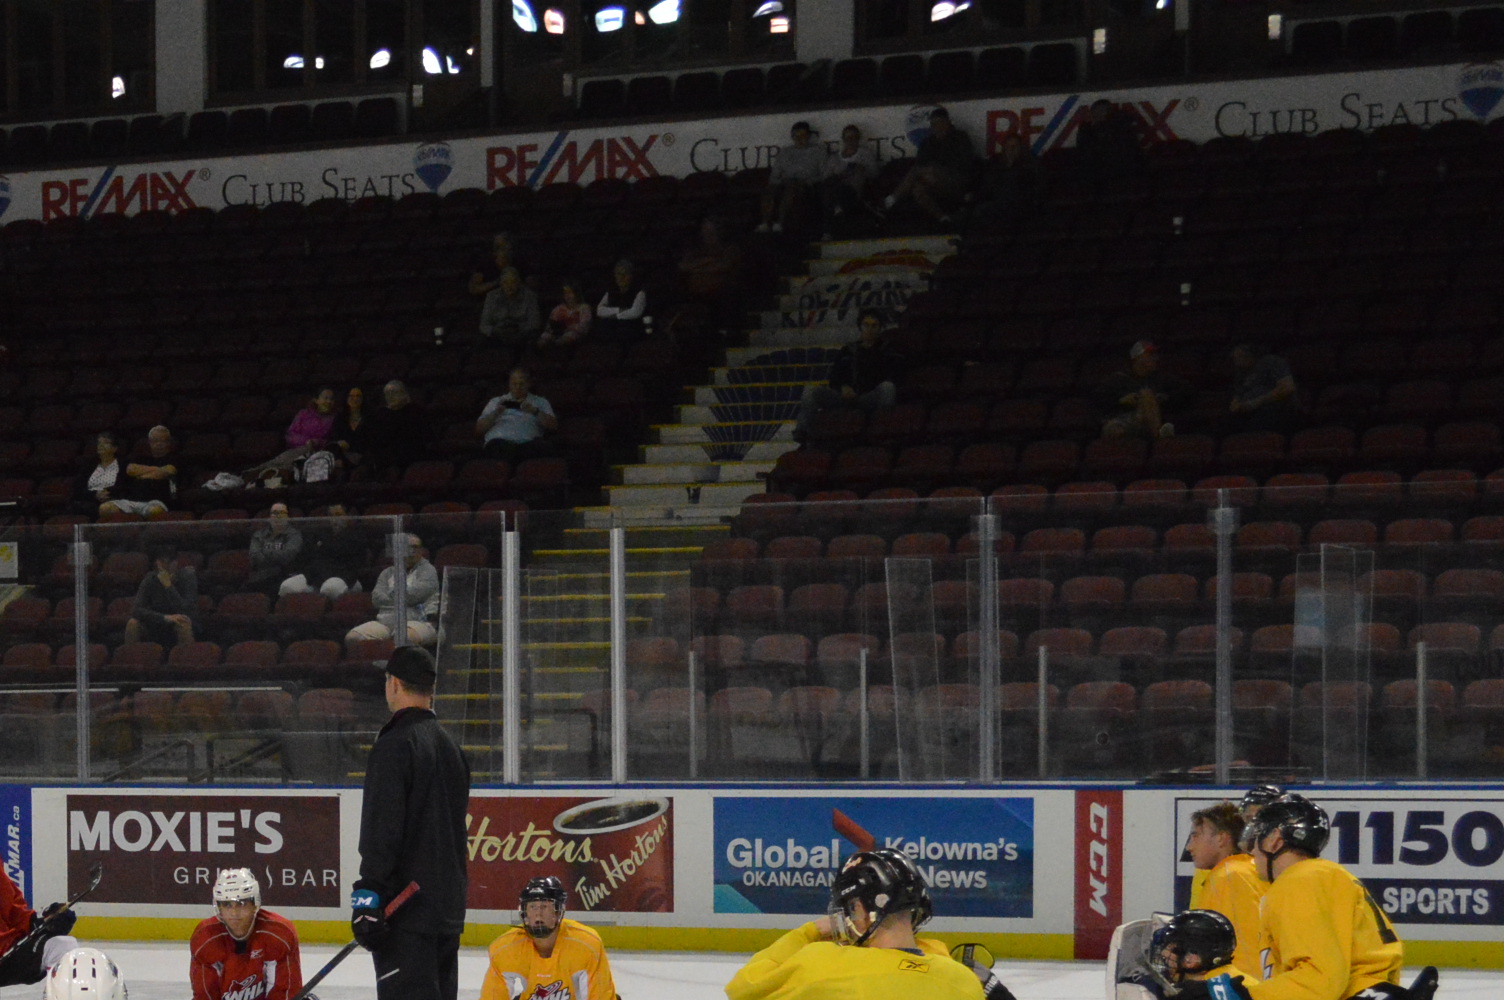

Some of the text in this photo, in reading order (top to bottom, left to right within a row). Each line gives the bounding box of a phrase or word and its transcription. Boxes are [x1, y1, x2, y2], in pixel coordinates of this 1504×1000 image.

[69, 809, 284, 854] MOXIE'S
[1331, 810, 1504, 867] 1150
[575, 815, 667, 910] Tim Hortons
[726, 838, 840, 868] Global
[885, 836, 1018, 861] Kelowna's
[1089, 801, 1109, 918] CCM
[282, 869, 338, 887] BAR
[923, 865, 987, 889] News
[1383, 887, 1490, 915] SPORTS
